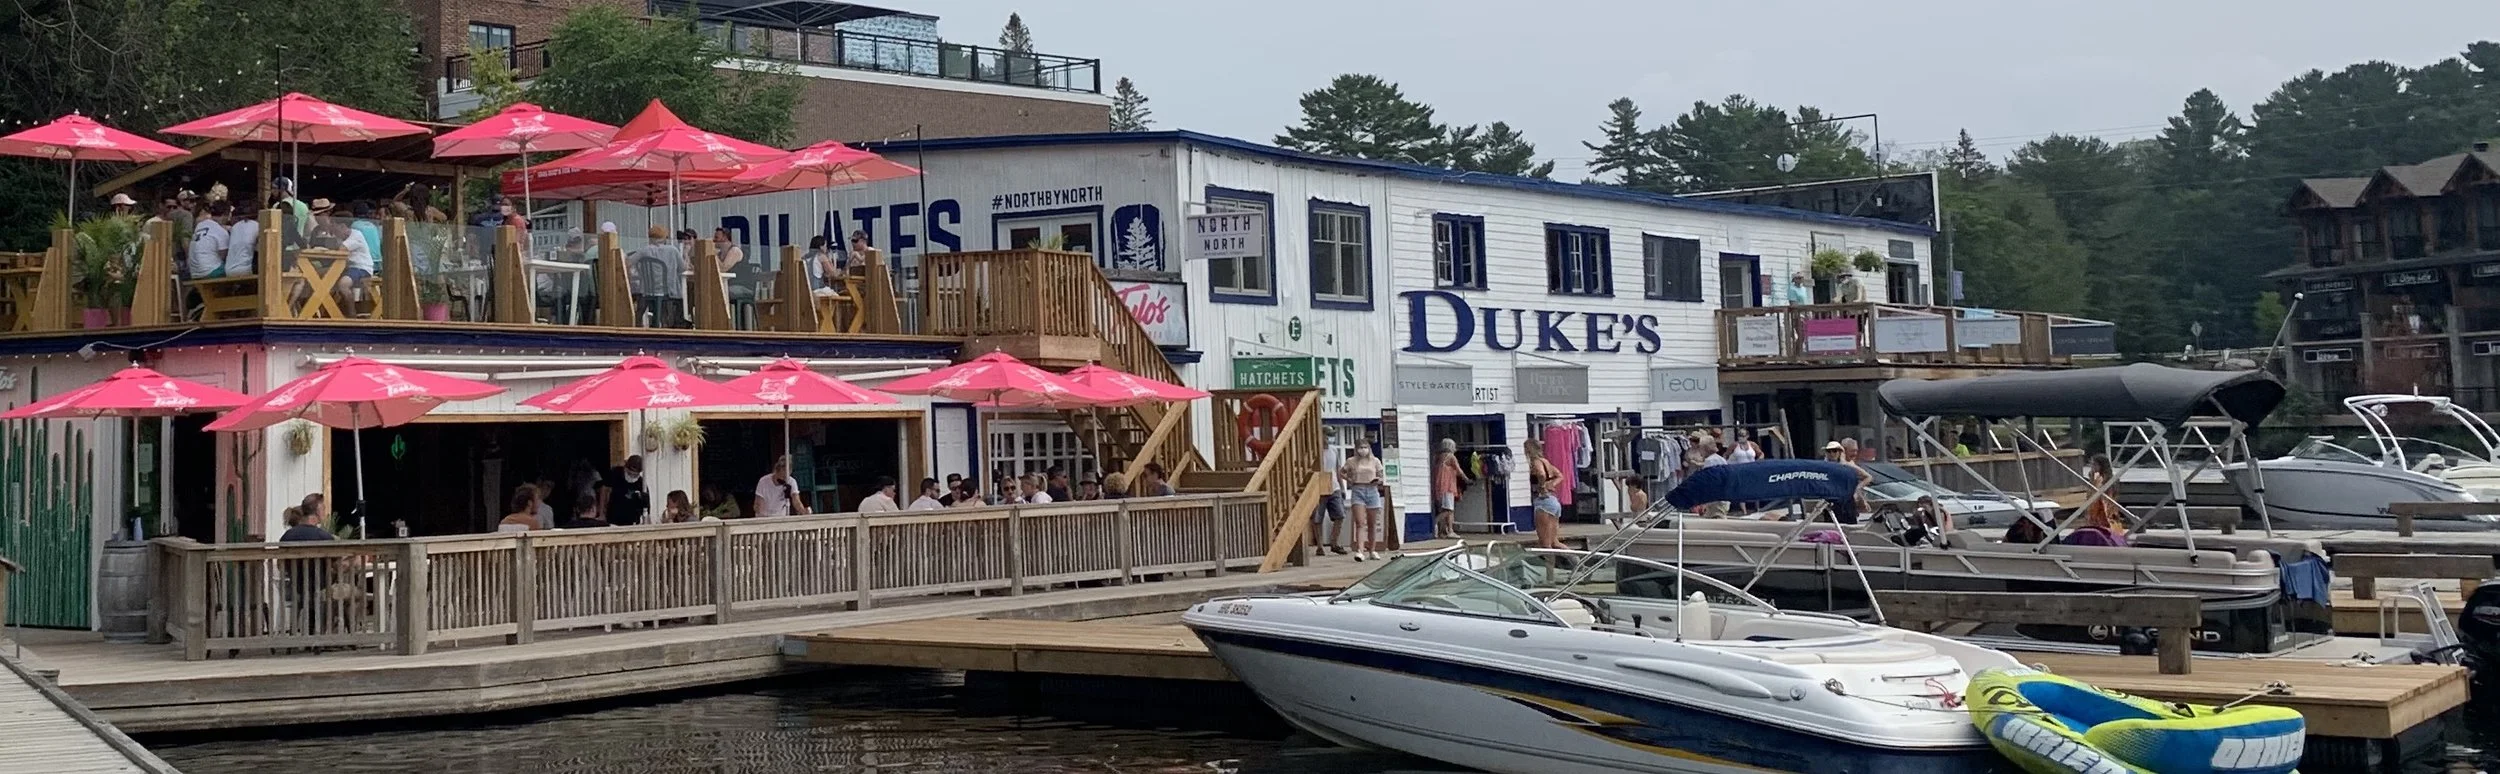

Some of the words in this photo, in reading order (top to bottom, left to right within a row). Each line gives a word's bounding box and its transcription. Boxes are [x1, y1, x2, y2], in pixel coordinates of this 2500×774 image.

[991, 185, 1103, 210] #NORTHBYNORTH
[1197, 215, 1251, 234] NORTH
[1203, 237, 1245, 251] NORTH
[1240, 372, 1305, 386] HATCHETS
[1661, 373, 1707, 392] l'eau
[1472, 387, 1499, 401] RTIST
[1768, 471, 1829, 483] CHAPARRAL
